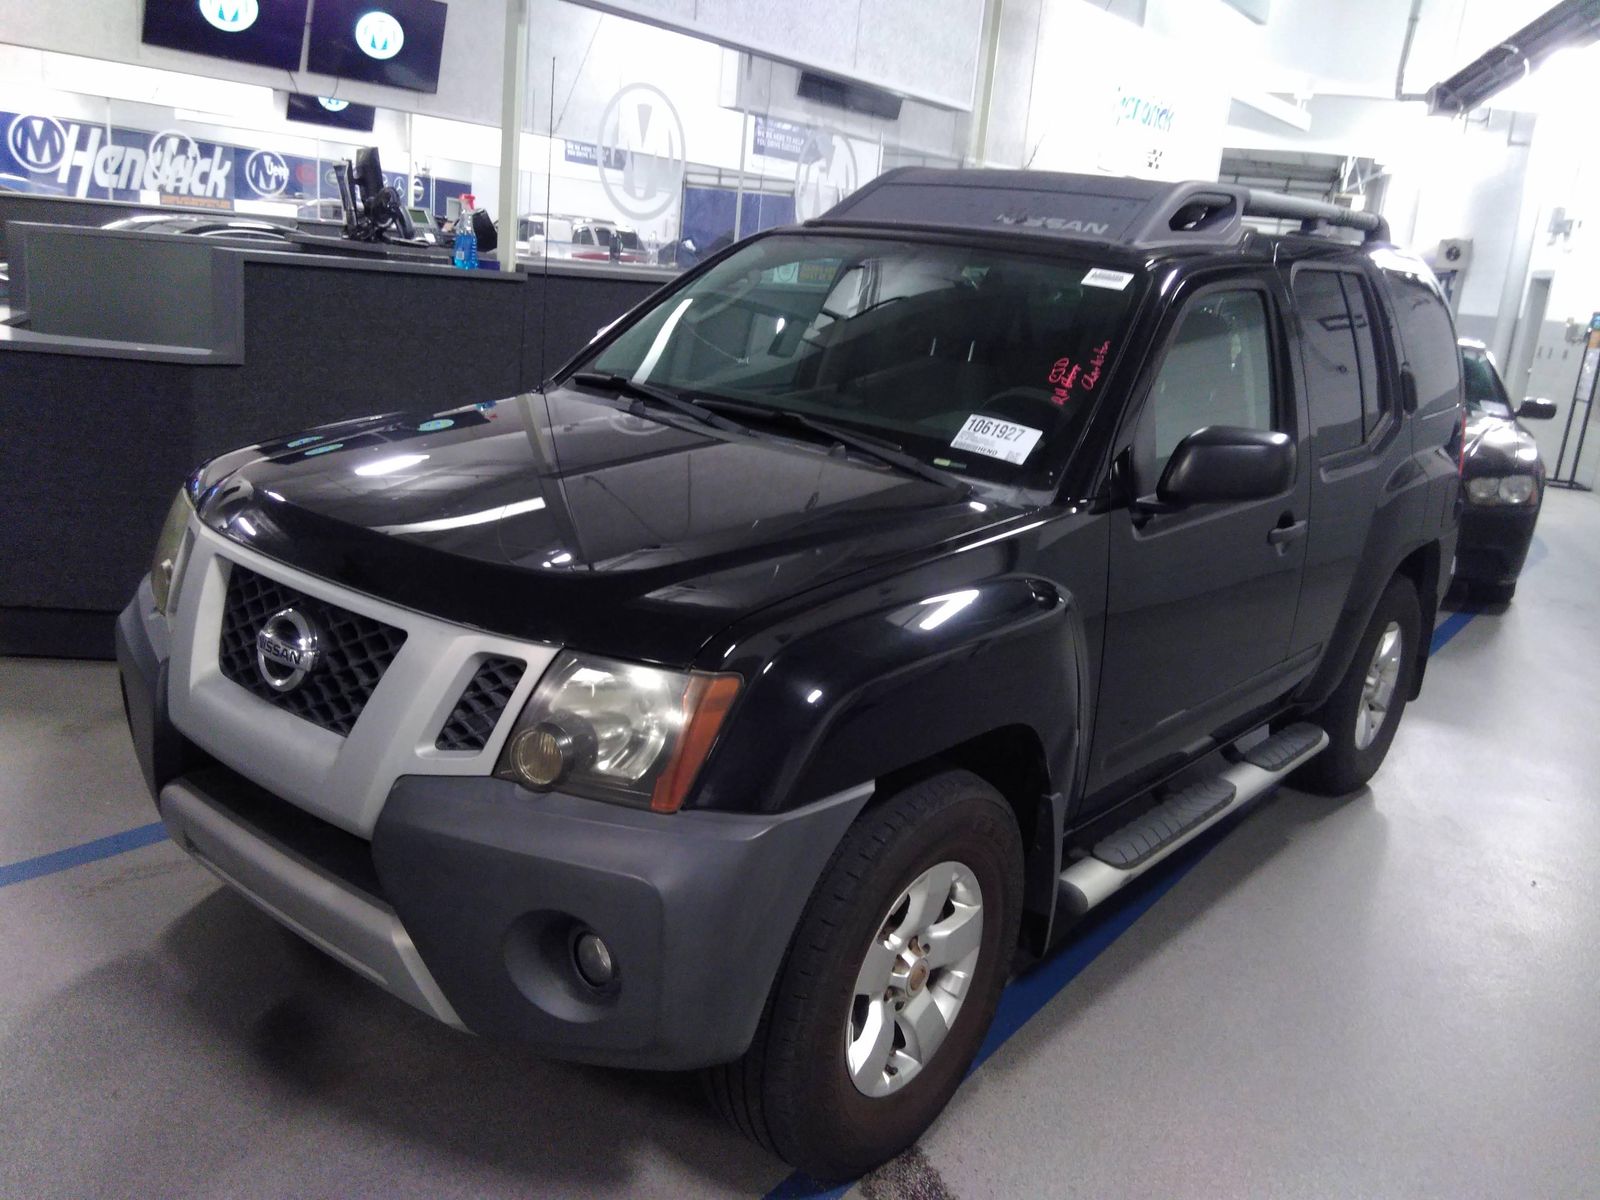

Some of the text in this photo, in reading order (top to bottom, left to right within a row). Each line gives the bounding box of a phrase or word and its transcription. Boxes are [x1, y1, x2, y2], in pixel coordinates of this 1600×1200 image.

[57, 124, 232, 199] Hendrick
[993, 213, 1110, 234] NSSAN
[968, 417, 1027, 442] 1061927
[259, 635, 302, 665] NISSAN
